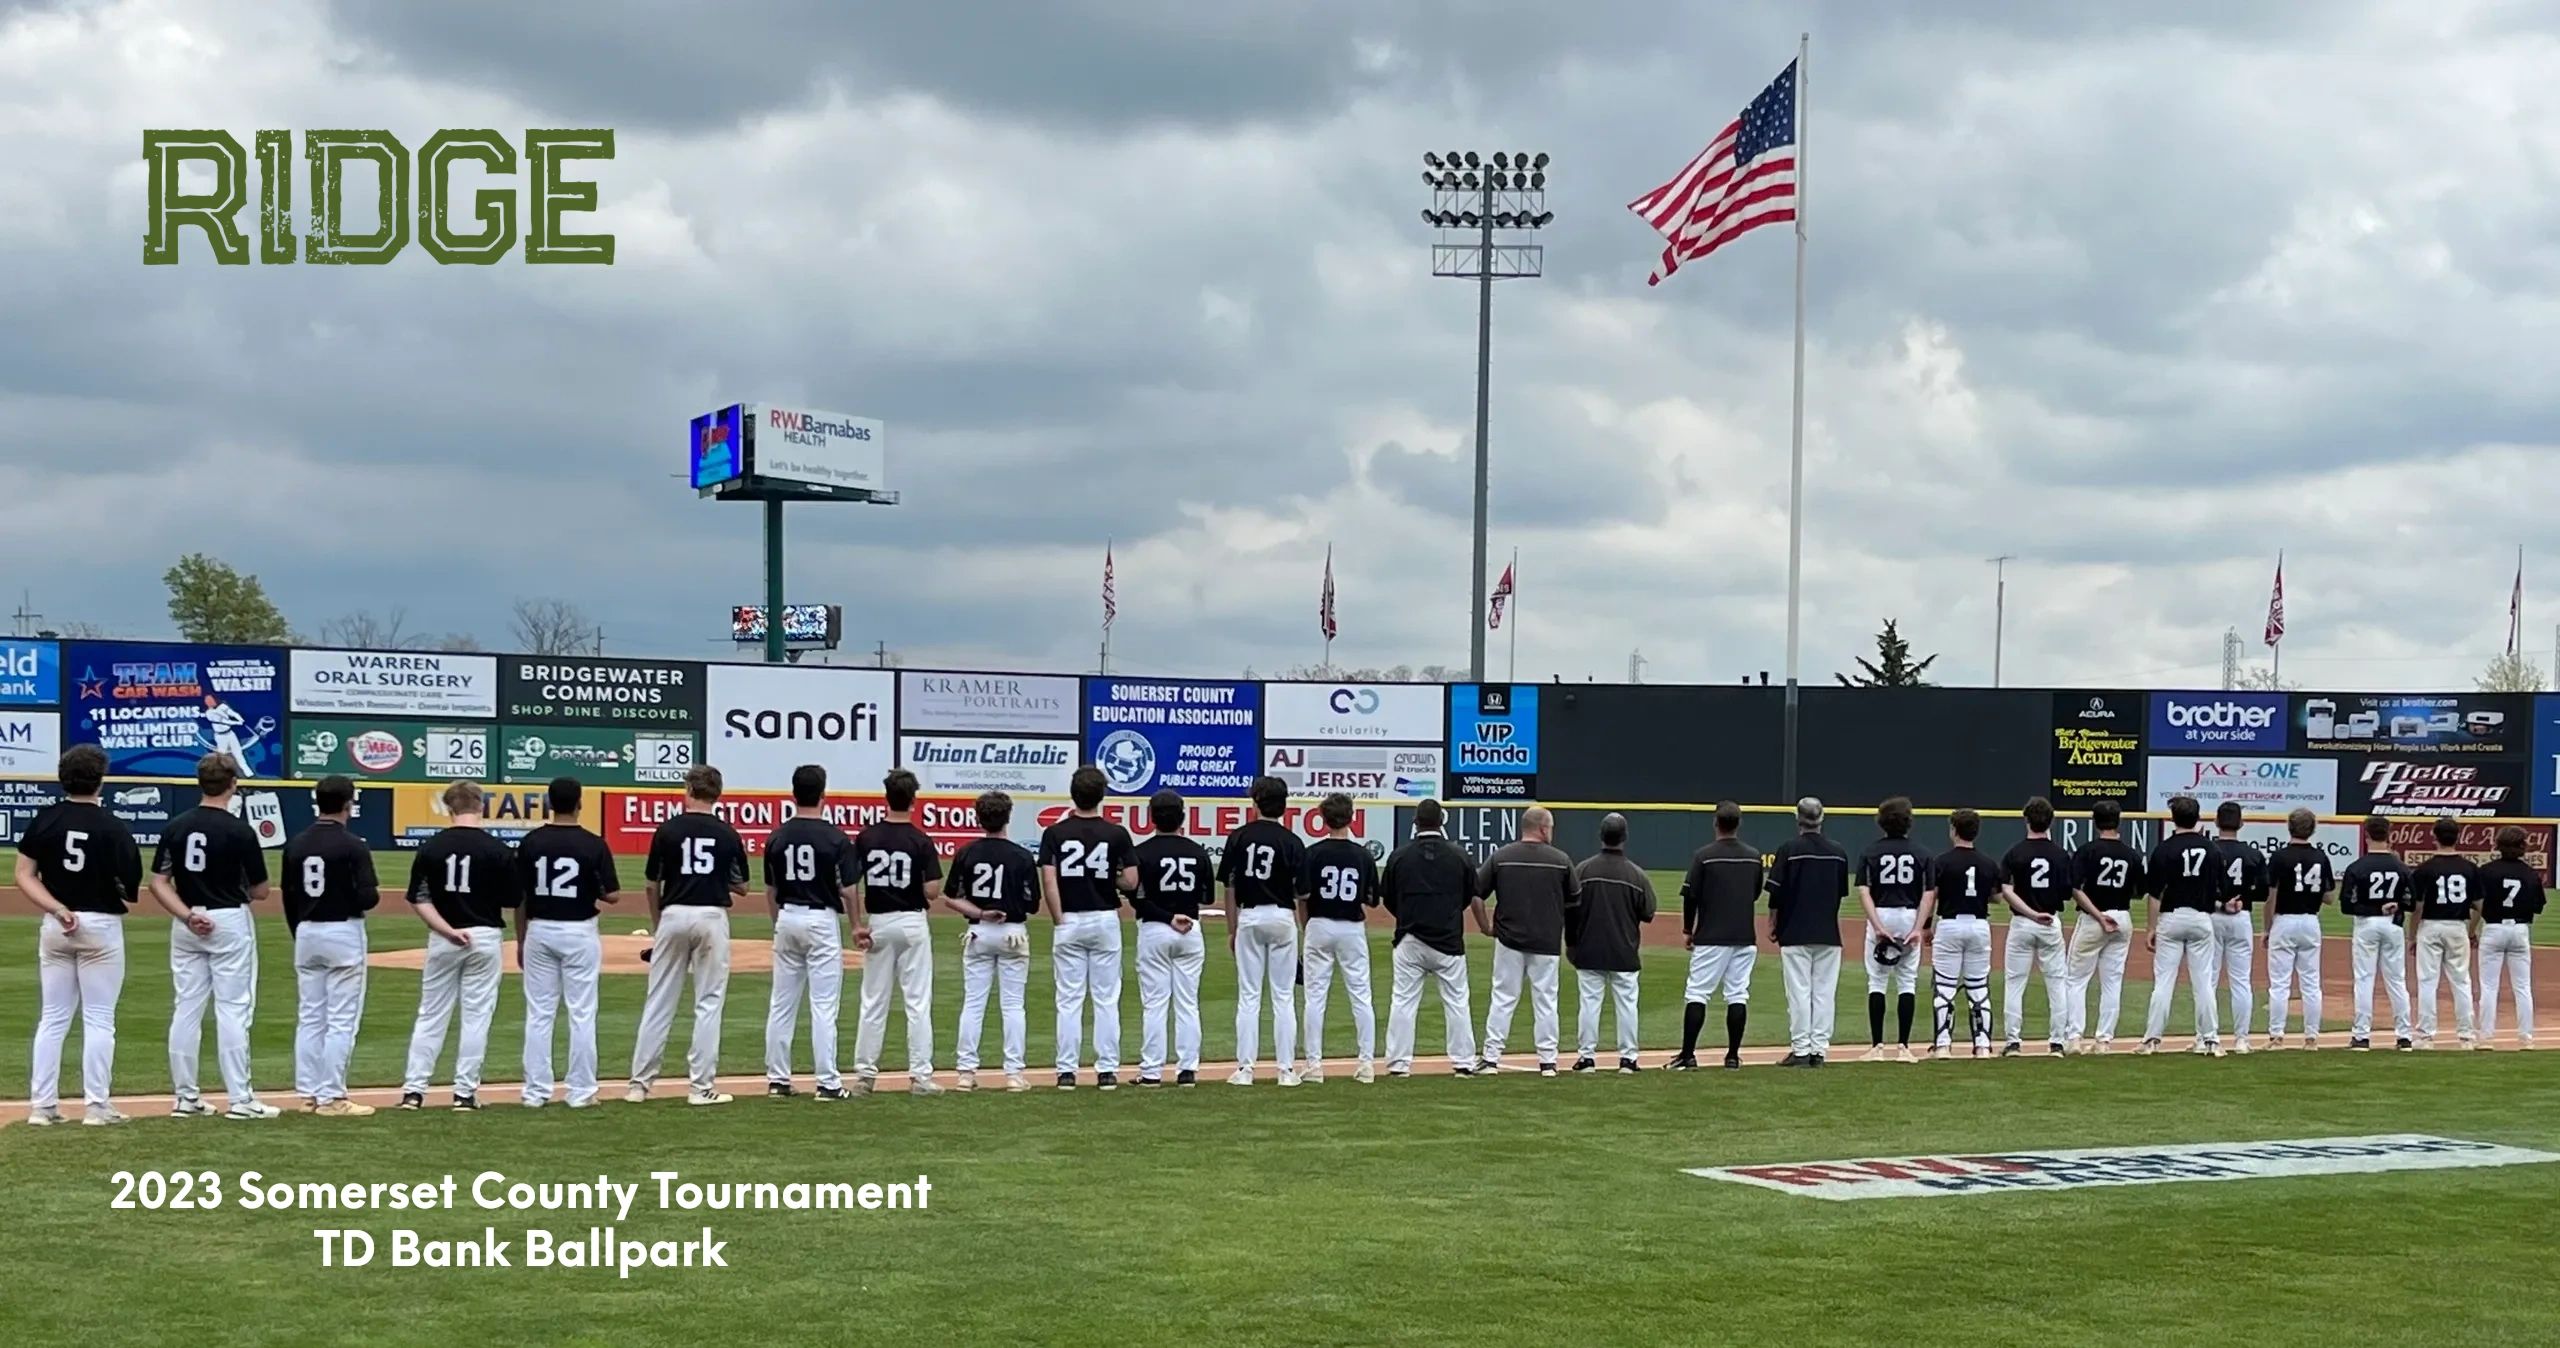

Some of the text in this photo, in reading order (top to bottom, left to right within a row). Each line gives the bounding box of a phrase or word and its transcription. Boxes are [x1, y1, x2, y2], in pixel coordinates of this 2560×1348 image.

[771, 409, 871, 441] RWJBarnabas
[784, 431, 826, 448] HEALTH
[802, 462, 832, 479] healthy
[206, 666, 276, 678] WINNERS
[348, 655, 440, 671] WARREN
[112, 662, 199, 687] TEAM
[315, 671, 472, 688] ORAL SURGERY
[520, 664, 684, 685] BRIDGEWATER
[113, 686, 201, 698] CAR WASH
[211, 678, 272, 692] WASH!
[542, 685, 662, 703] COMMONS
[923, 678, 1022, 695] KRAMER
[1111, 684, 1235, 704] SOMERSET COUNTY
[295, 699, 491, 713] Wisdom Teeth Removal Dental Implants
[963, 695, 1060, 710] PORTRAITS
[2360, 698, 2377, 707] Visit
[2380, 699, 2390, 707] us
[2402, 698, 2458, 708] brother.com
[89, 706, 205, 721] 11 LOCATIONS.
[612, 707, 693, 720] DISCOVER.
[725, 703, 877, 741] sanofi
[1093, 706, 1253, 726] EDUCATION ASSOCIATION
[2079, 710, 2115, 718] ACURA
[2167, 701, 2276, 727] brother
[98, 722, 199, 736] 1 UNLIMITED
[1319, 725, 1389, 737] celularity
[1475, 722, 1514, 745] VIP
[2185, 729, 2256, 743] at your side
[99, 735, 199, 749] WASH CLUB.
[413, 738, 485, 759] $ 26
[1179, 744, 1233, 758] PROUD OF
[2058, 736, 2138, 751] Bridgewater
[2307, 741, 2371, 752] Revolutionizing
[2374, 742, 2392, 751] How
[2394, 743, 2419, 753] People
[2462, 743, 2476, 752] and
[623, 744, 635, 763] $
[658, 744, 690, 764] 28
[913, 741, 1068, 765] Union Catholic
[1270, 749, 1305, 768] AJ
[1459, 742, 1529, 767] Honda
[2068, 746, 2123, 765] Acura
[428, 765, 485, 776] MILLION
[956, 770, 1025, 780] HIGH SCHOOL
[1176, 760, 1237, 773] OUR GREAT
[2184, 762, 2301, 789] JAG-ONE
[2360, 761, 2478, 782] Hicks
[935, 782, 1046, 793] www.unioncatholic.org
[1159, 774, 1254, 788] PUBLIC SCHOOLS!
[1305, 772, 1386, 788] JERSEY
[1464, 776, 1523, 785] VIPHonda.com
[2200, 778, 2300, 789] PHYSICAL THERAPY
[2371, 780, 2510, 803] Paving
[250, 804, 277, 820] Lite
[625, 796, 772, 824] FLEMGTON
[2372, 805, 2496, 817] HicksPaving.com
[63, 830, 89, 872] 5
[185, 832, 207, 872] 6
[681, 837, 716, 875] 15
[1060, 839, 1109, 879] 24
[2327, 842, 2352, 857] Co.
[784, 844, 815, 881] 19
[867, 849, 912, 888] 20
[1245, 842, 1275, 880] 13
[1880, 854, 1914, 884] 26
[2182, 847, 2206, 877] 17
[302, 856, 325, 897] 8
[445, 853, 471, 893] 11
[535, 856, 580, 898] 12
[972, 862, 1004, 899] 21
[1160, 857, 1197, 892] 25
[1965, 866, 1977, 897] 1
[2030, 858, 2050, 888] 2
[2096, 857, 2128, 888] 23
[2227, 857, 2243, 886] 4
[2294, 863, 2322, 892] 14
[1320, 866, 1359, 902] 36
[2369, 871, 2400, 899] 27
[2435, 874, 2468, 904] 18
[2503, 879, 2521, 907] 7
[1917, 1165, 2258, 1190] HEALTH
